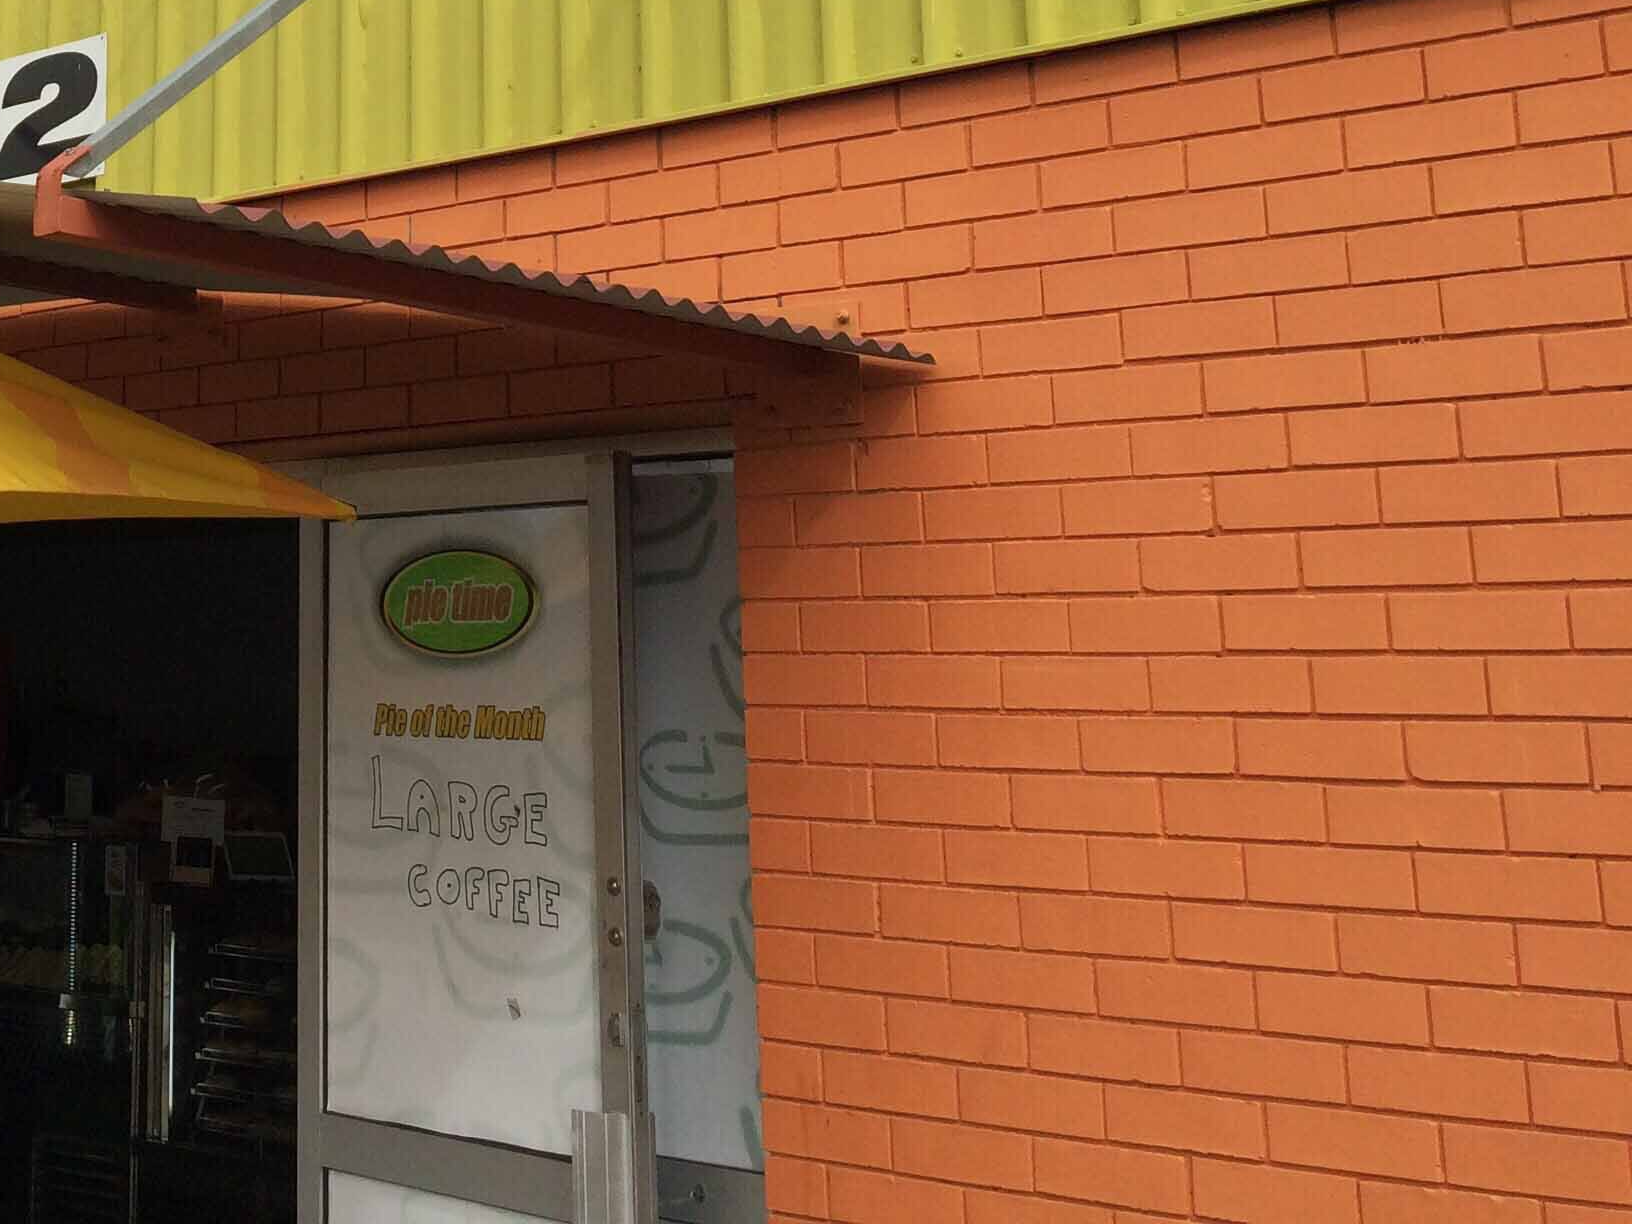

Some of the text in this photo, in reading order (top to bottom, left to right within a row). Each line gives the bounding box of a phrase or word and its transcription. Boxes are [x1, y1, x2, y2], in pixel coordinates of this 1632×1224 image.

[402, 578, 515, 631] pie time
[373, 702, 545, 741] Pie of the Month
[371, 755, 548, 847] LARGE
[407, 863, 561, 928] COFFEE
